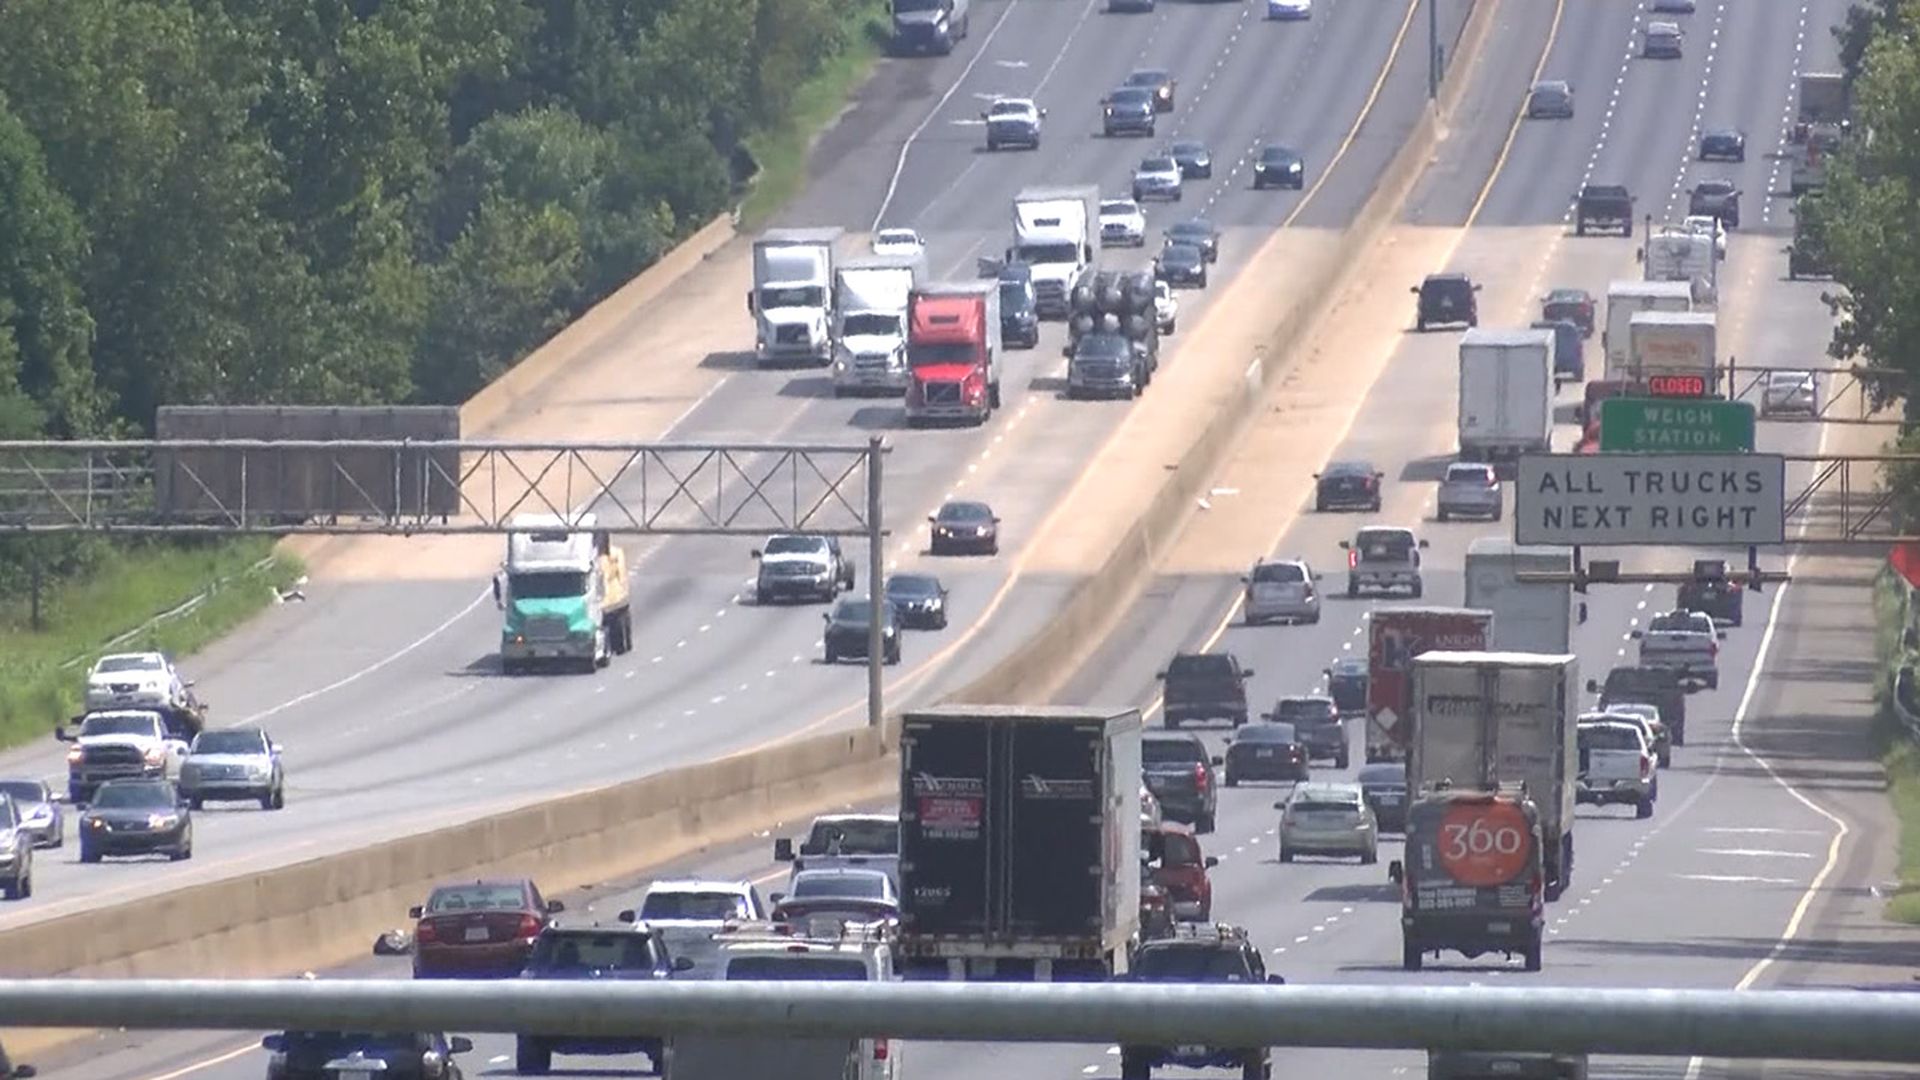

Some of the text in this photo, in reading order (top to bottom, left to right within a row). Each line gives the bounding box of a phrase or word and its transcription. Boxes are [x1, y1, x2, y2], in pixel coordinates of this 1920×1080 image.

[1651, 378, 1703, 394] CLOSED
[1643, 407, 1713, 425] WEIGH
[1635, 429, 1722, 445] STATION
[1539, 471, 1763, 494] ALL TRUCKS
[1543, 507, 1757, 529] NEXT RIGHT
[1444, 818, 1522, 860] 360
